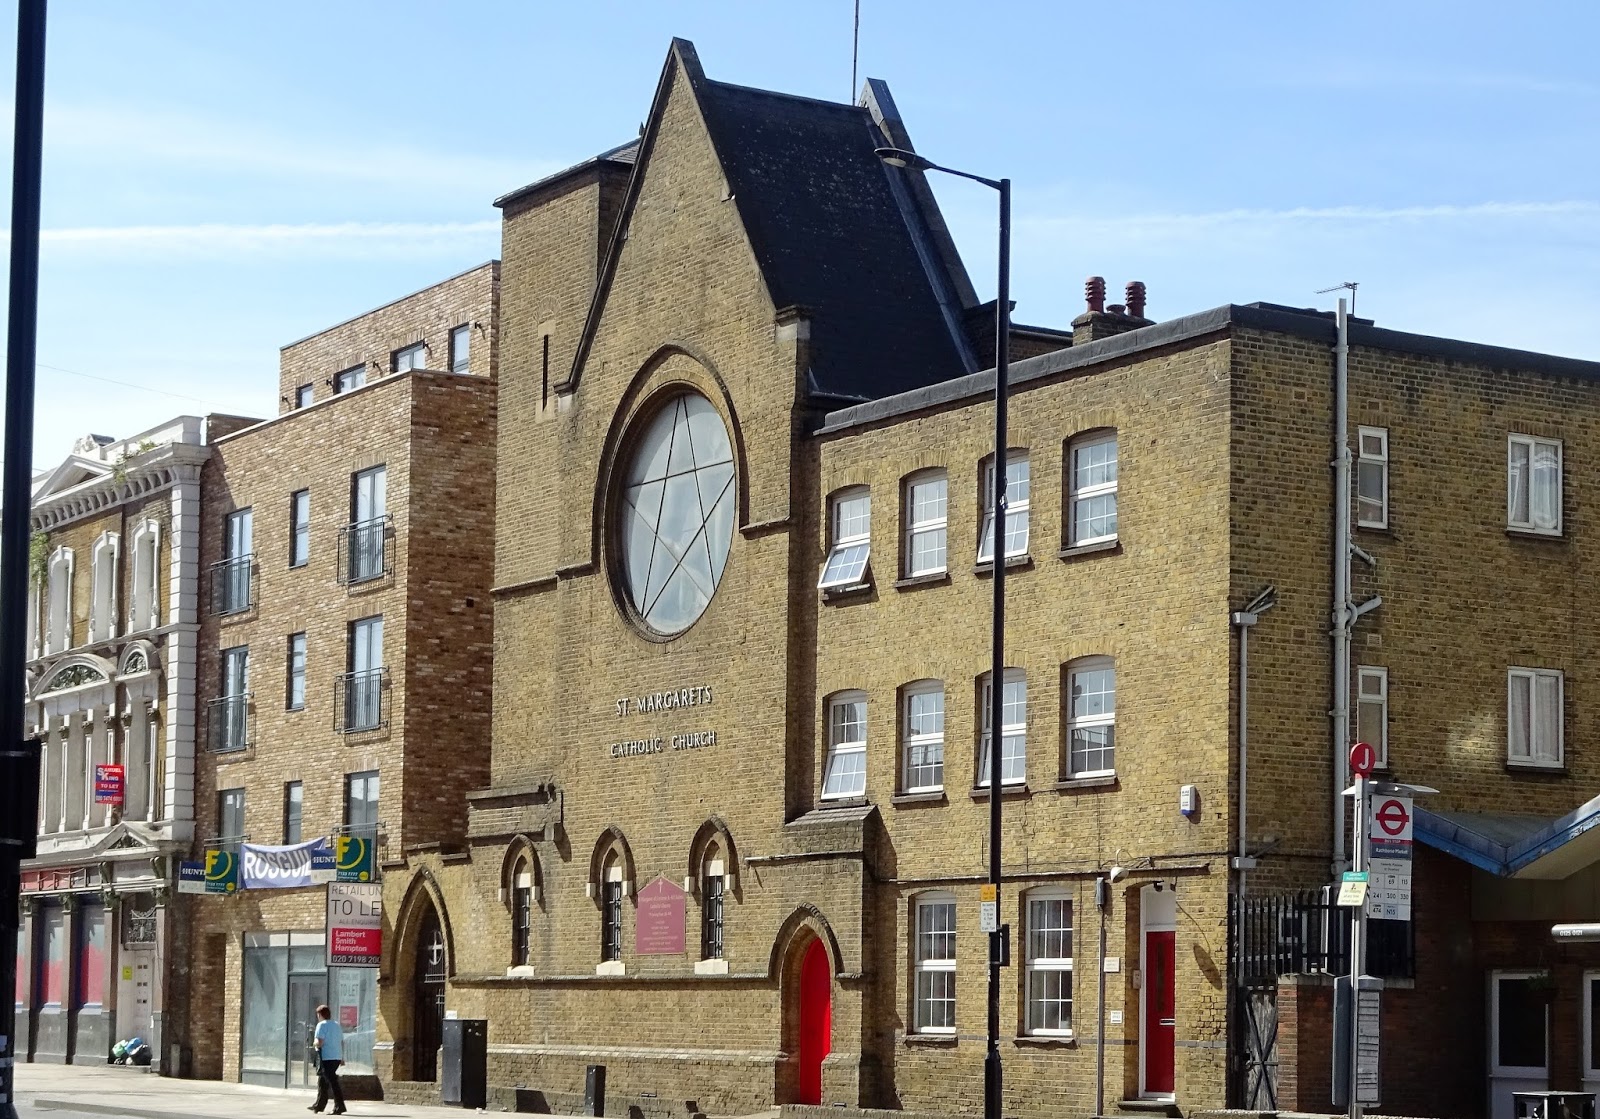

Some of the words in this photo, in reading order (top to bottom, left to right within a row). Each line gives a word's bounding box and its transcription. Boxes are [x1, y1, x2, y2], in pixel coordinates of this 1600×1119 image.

[610, 737, 662, 757] CATHOLIC
[671, 730, 717, 750] CHURCH
[1358, 747, 1370, 771] J
[331, 885, 365, 896] RETAIL
[331, 899, 353, 916] TO
[335, 930, 366, 938] Lambert
[335, 937, 356, 945] Smith
[335, 944, 368, 953] Hampton
[332, 955, 346, 963] 020
[348, 955, 366, 963] 7198
